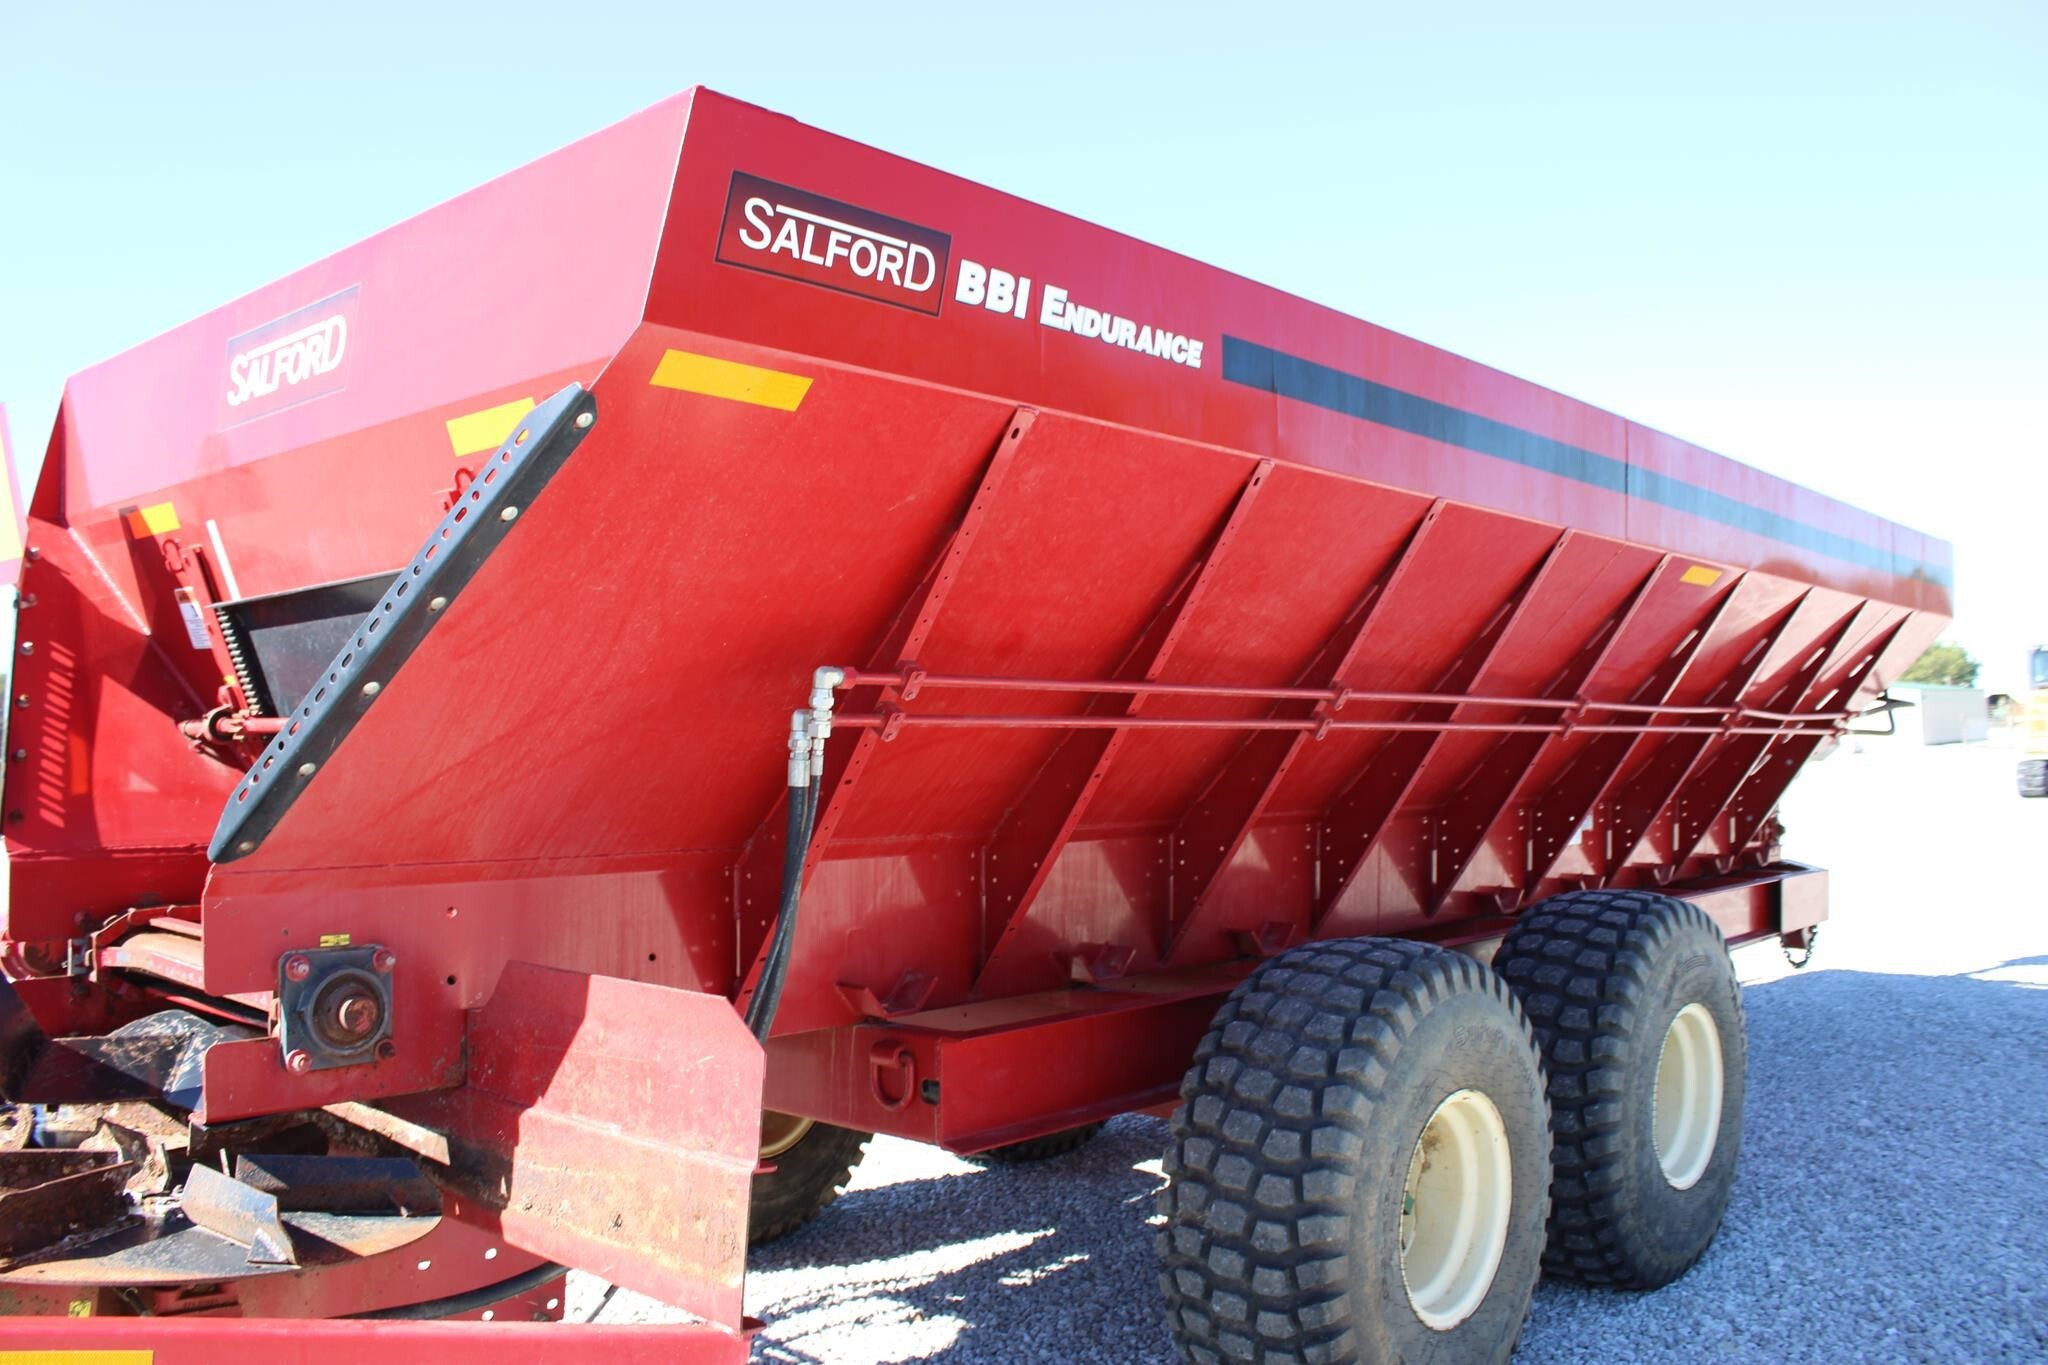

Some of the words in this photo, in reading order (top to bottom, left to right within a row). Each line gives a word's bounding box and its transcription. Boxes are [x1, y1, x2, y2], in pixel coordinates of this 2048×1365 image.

[738, 196, 937, 292] SALFORD
[227, 314, 347, 407] SALFORD
[954, 258, 1032, 320] BBI
[1039, 284, 1204, 369] ENDURANCE
